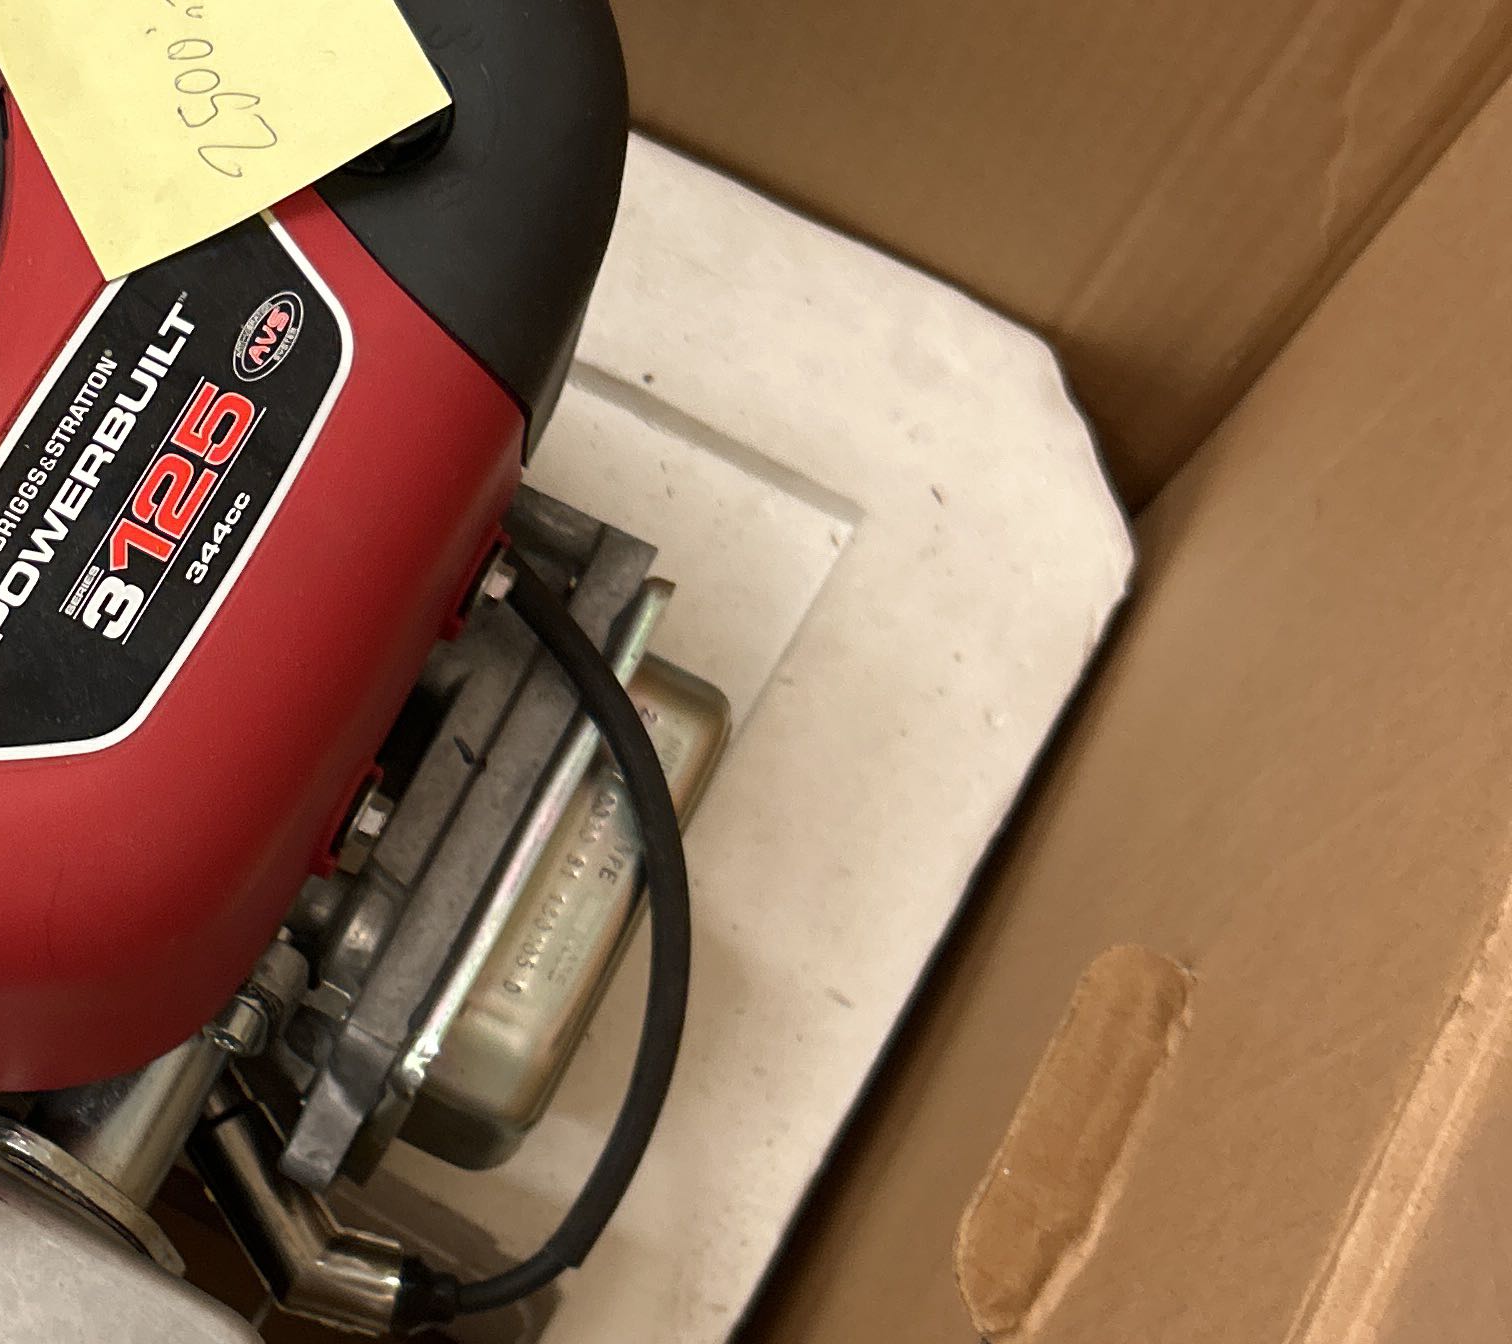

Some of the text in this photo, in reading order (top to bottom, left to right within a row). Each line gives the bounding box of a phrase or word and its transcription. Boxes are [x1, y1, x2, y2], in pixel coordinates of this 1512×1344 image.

[249, 306, 289, 365] AVS
[185, 492, 251, 584] 344cc
[64, 565, 100, 616] SERIES
